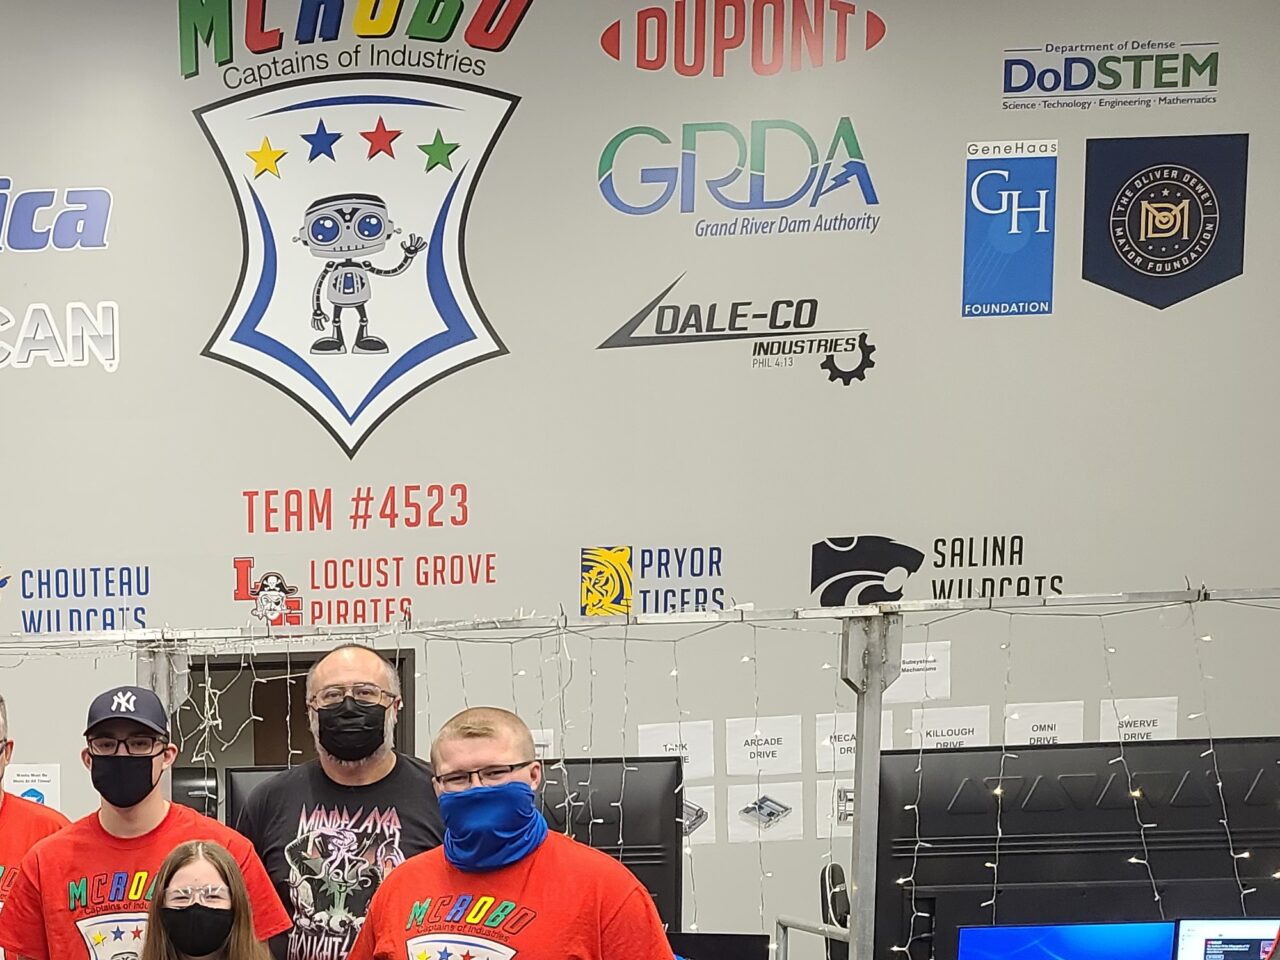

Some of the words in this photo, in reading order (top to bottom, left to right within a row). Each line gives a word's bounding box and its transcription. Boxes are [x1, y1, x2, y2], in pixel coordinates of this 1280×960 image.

[636, 0, 856, 77] DUPONT
[1045, 43, 1113, 55] Department
[1117, 41, 1128, 50] of
[1131, 40, 1176, 50] Defense
[222, 49, 329, 90] Captains
[338, 44, 363, 68] of
[370, 44, 487, 77] Industries
[1002, 101, 1036, 110] Science
[1042, 100, 1092, 110] Technology
[1098, 98, 1152, 108] Engineering
[1158, 95, 1217, 105] Mathematics
[598, 116, 880, 216] GRDA
[971, 170, 1050, 234] GH
[1116, 189, 1134, 212] THE
[1182, 173, 1213, 207] DEWEY
[695, 218, 738, 237] Grand
[740, 217, 776, 235] River
[778, 216, 811, 234] Dam
[813, 212, 881, 234] Authority
[1114, 227, 1143, 266] MAYOR
[1147, 223, 1214, 272] FOUNDATION
[654, 299, 819, 335] DALE-CO
[965, 302, 1049, 315] FOUNDATION
[752, 337, 857, 356] INDUSTRIES
[752, 358, 772, 369] PHIL
[774, 357, 793, 368] 4:13
[242, 488, 332, 533] TEAM
[349, 483, 469, 531] #4523
[640, 547, 722, 579] PRYOR
[933, 535, 1024, 568] SALINA
[21, 566, 150, 599] CHOUTEAU
[310, 557, 404, 590] LOCUST
[416, 553, 497, 586] GROVE
[639, 587, 724, 613] TIGERS
[931, 575, 1063, 600] WILDCATS
[21, 607, 146, 633] WILDCATS
[310, 597, 412, 625] PIRATES
[925, 728, 975, 739] KILLOUGH
[1031, 723, 1057, 733] OMNI
[1118, 719, 1159, 729] SWERVE
[1123, 732, 1153, 741] DRIVE
[743, 737, 784, 747] ARCADE
[829, 734, 856, 743] MECA
[839, 746, 855, 755] DRI
[935, 740, 965, 748] DRIVE
[1029, 736, 1058, 745] DRIVE
[749, 750, 778, 760] DRIVE
[68, 871, 158, 911] MCRO
[405, 894, 537, 935] MCROBO
